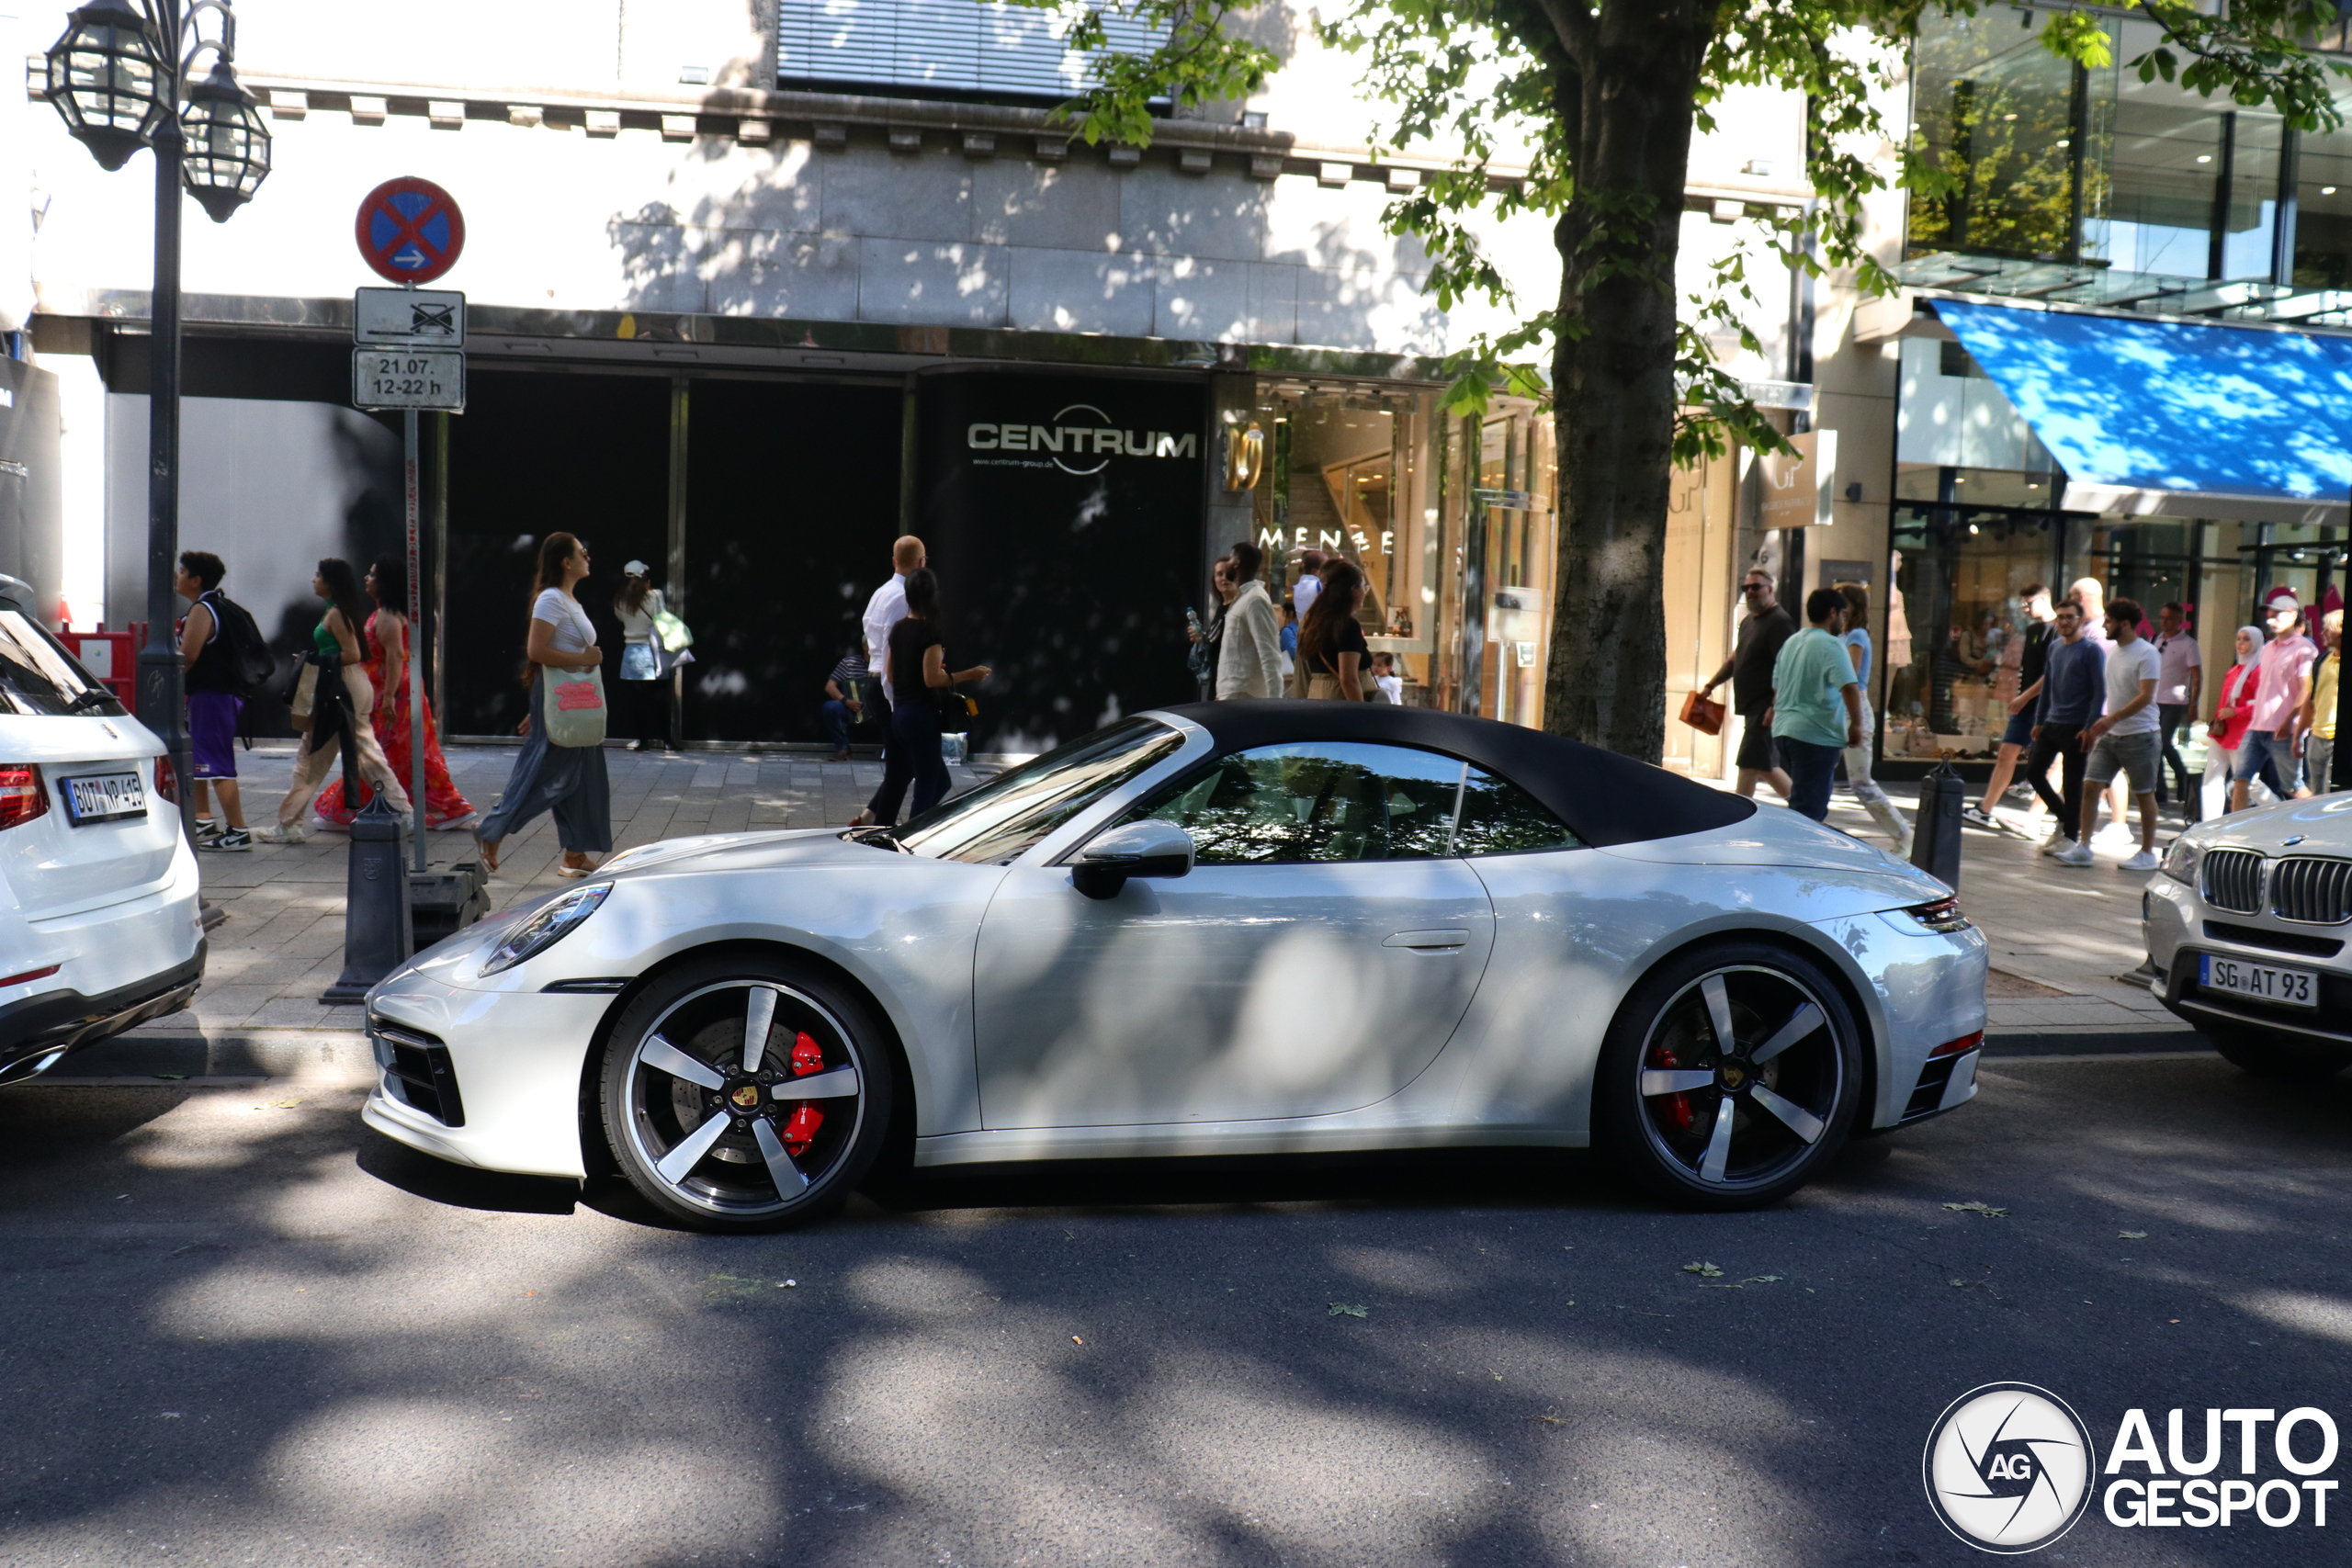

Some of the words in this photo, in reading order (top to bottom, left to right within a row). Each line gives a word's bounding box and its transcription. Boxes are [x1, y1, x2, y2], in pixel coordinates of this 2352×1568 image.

[379, 359, 435, 375] 21.07.
[373, 379, 424, 395] 12-22
[430, 379, 441, 395] h
[967, 423, 1195, 458] CENTRUM
[972, 457, 1054, 468] www.centrum-group.de
[73, 782, 99, 813] BOT
[103, 780, 119, 809] NP
[120, 778, 142, 807] 415
[2215, 962, 2238, 988] SG
[2251, 967, 2276, 995] AT
[2282, 974, 2309, 1000] 93
